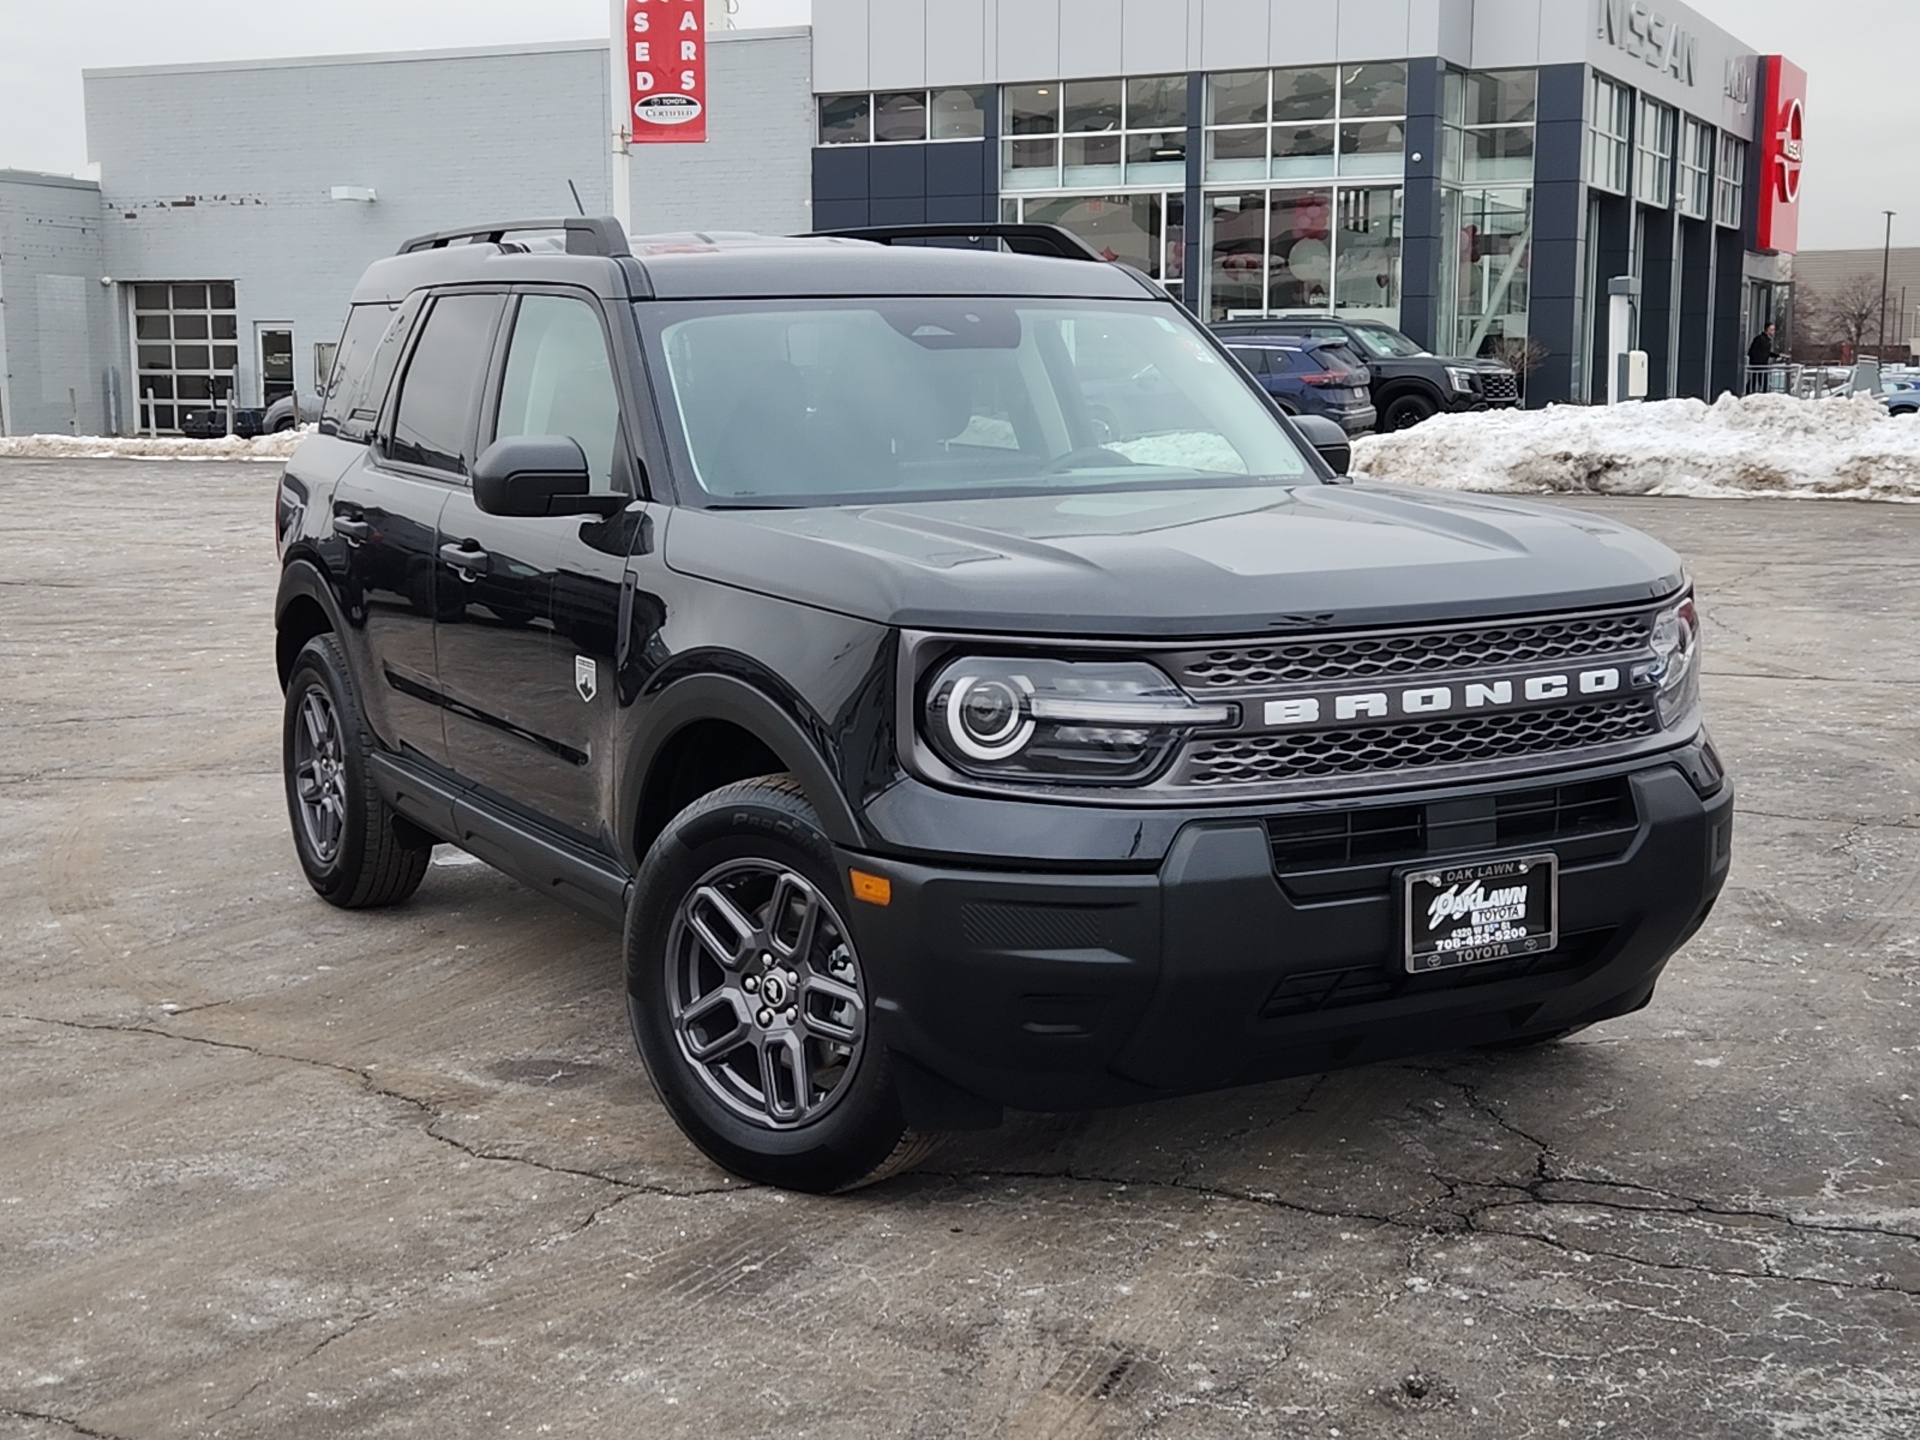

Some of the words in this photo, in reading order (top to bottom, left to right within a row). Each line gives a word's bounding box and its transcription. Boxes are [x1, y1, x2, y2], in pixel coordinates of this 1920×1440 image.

[633, 0, 654, 91] SED
[679, 0, 698, 91] ARS
[1597, 0, 1699, 87] NISSAN
[1264, 668, 1619, 725] BRONCO
[1446, 868, 1473, 882] OAK
[1477, 862, 1515, 878] LAWN
[1478, 906, 1519, 923] TOYOTA
[1435, 926, 1527, 951] 708-423-5200
[1456, 943, 1509, 963] TOYOTA
